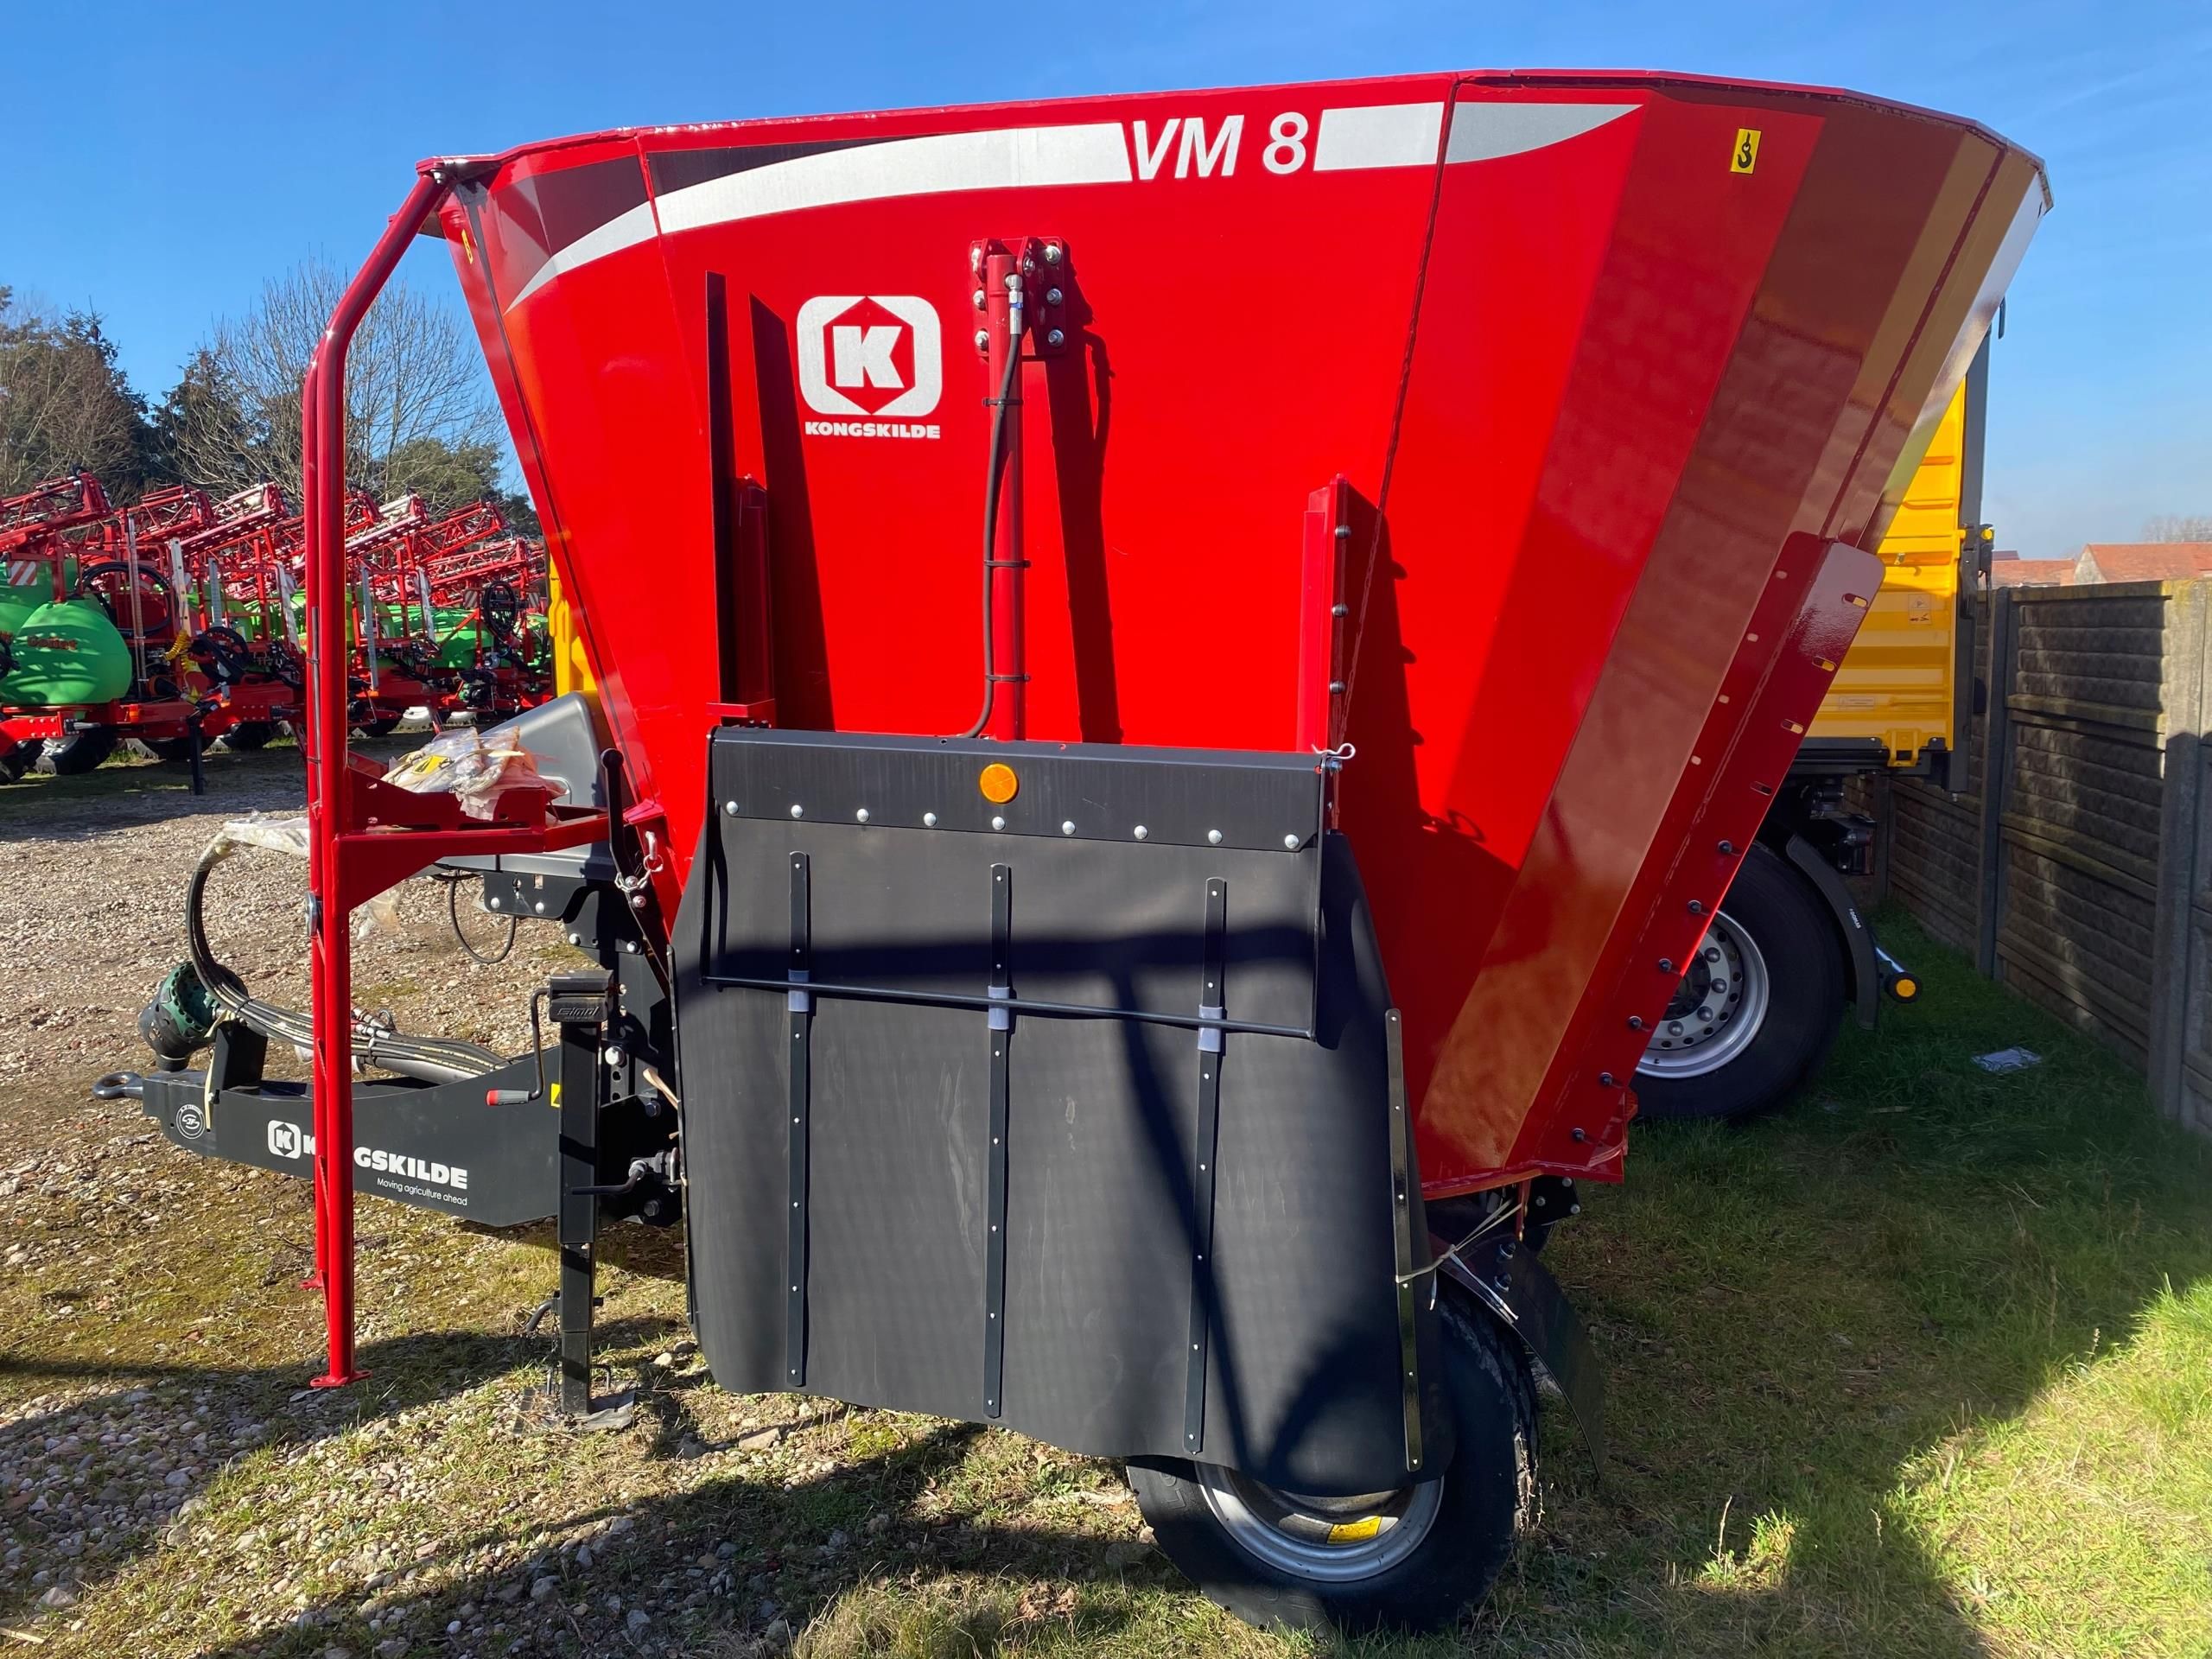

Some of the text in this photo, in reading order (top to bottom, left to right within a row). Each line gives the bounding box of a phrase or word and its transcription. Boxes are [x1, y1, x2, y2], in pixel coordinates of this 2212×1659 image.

[1133, 111, 1309, 181] VM 8
[804, 421, 941, 440] KONGSKILDE
[302, 1134, 467, 1190] KGSKILDE
[377, 1177, 467, 1206] Moving agriculture ahead
